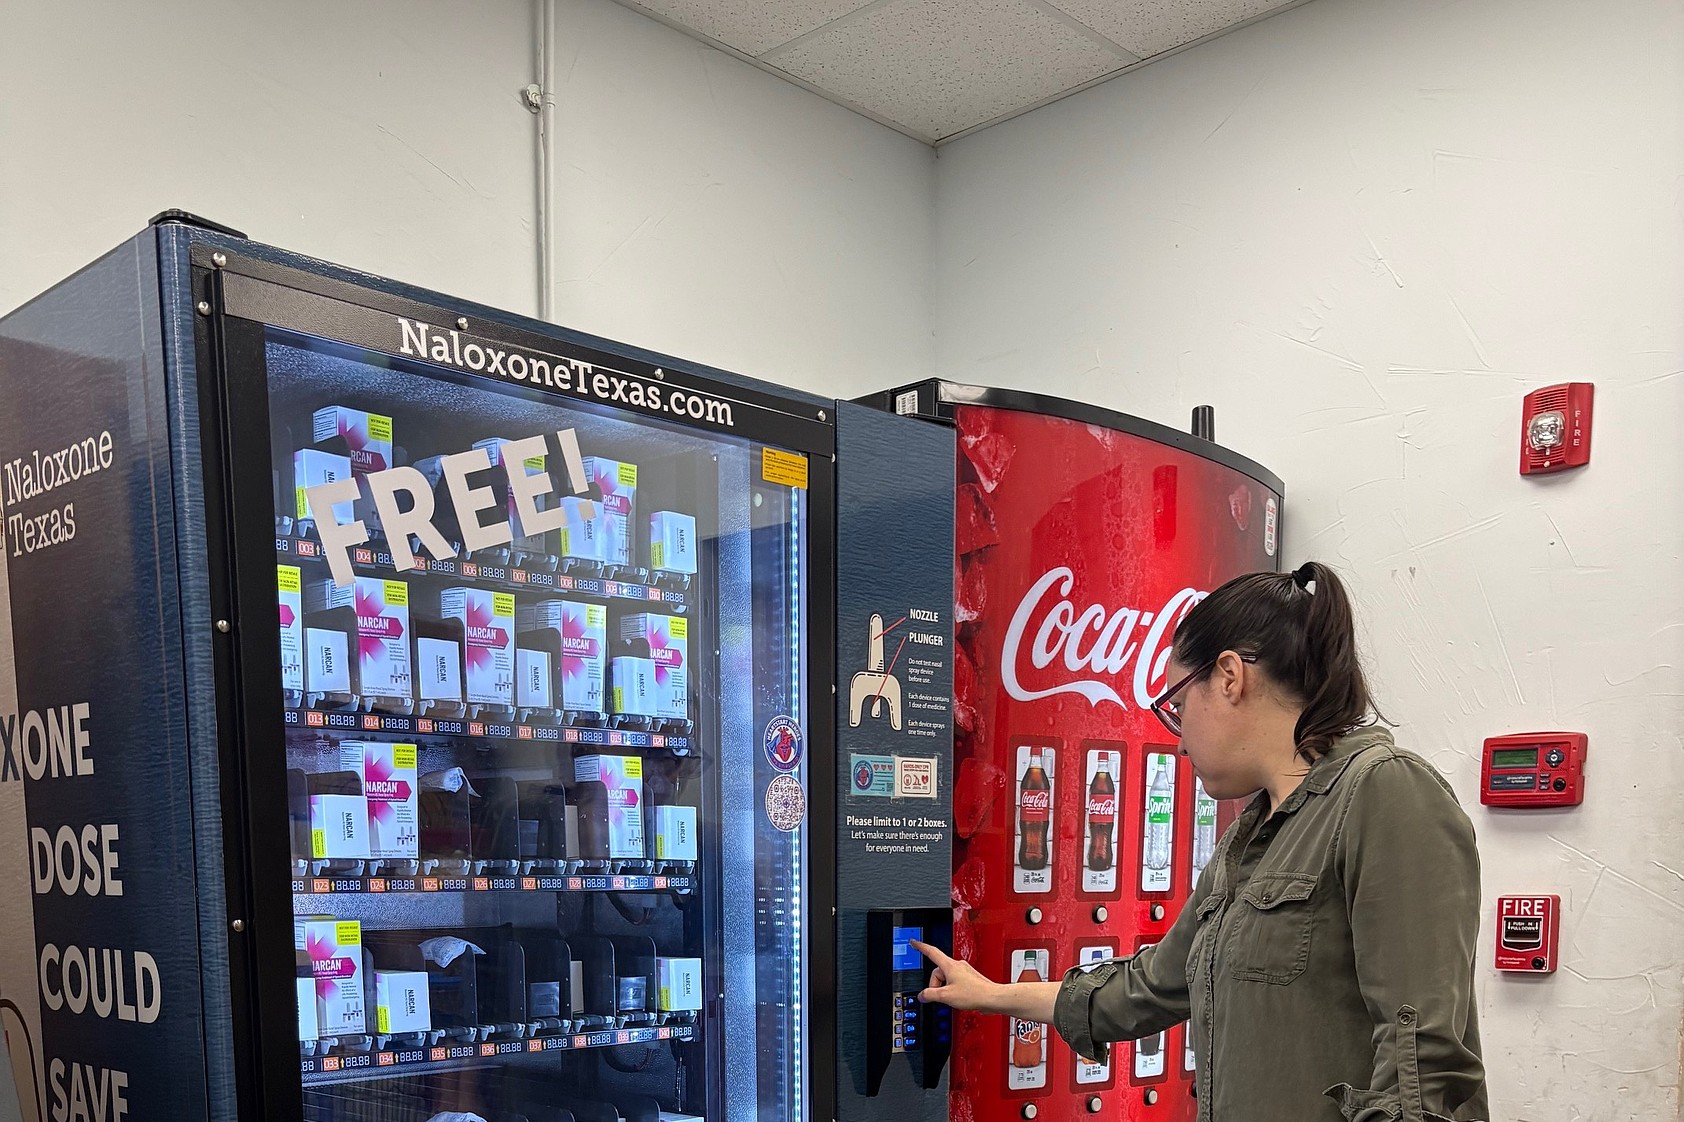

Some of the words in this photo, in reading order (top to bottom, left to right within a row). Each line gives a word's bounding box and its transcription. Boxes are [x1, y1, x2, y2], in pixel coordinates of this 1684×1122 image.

[398, 318, 734, 427] NaloxoneTexas.com
[1572, 410, 1582, 446] FIRE
[351, 449, 372, 464] RCAN
[5, 431, 113, 506] Naloxone
[305, 428, 597, 587] FREE!
[9, 503, 76, 557] Texas
[909, 608, 939, 622] NOZZLE
[357, 616, 389, 630] NARCAN
[467, 627, 497, 641] NARCAN
[909, 632, 943, 646] PLUNGER
[563, 637, 590, 650] NARCAN
[324, 647, 334, 674] NARCAN
[439, 655, 447, 683] NARCAN
[920, 668, 934, 676] device
[908, 675, 922, 683] before
[908, 692, 918, 700] Each
[927, 703, 947, 711] medicine.
[307, 713, 323, 725] 013
[908, 719, 918, 727] Each
[932, 722, 945, 730] sprays
[519, 726, 532, 739] 017
[926, 730, 937, 738] only.
[366, 780, 398, 794] NARCAN
[345, 812, 354, 839] NARCAN
[846, 815, 872, 826] Please
[873, 815, 892, 827] limit
[892, 817, 901, 827] to
[902, 817, 906, 827] 1
[908, 819, 917, 827] or
[917, 817, 923, 827] 2
[923, 817, 948, 828] boxes.
[851, 830, 866, 839] Let's
[866, 830, 884, 840] make
[884, 832, 898, 840] sure
[899, 831, 919, 840] there's
[919, 831, 943, 842] enough
[865, 842, 875, 852] for
[875, 844, 905, 854] everyone
[905, 844, 911, 852] in
[912, 844, 930, 853] need.
[31, 823, 124, 897] DOSE
[314, 880, 329, 891] 023
[1502, 899, 1545, 916] FIRE
[39, 943, 162, 1025] COULD
[407, 989, 416, 1015] NARCAN
[323, 1058, 340, 1070] 033
